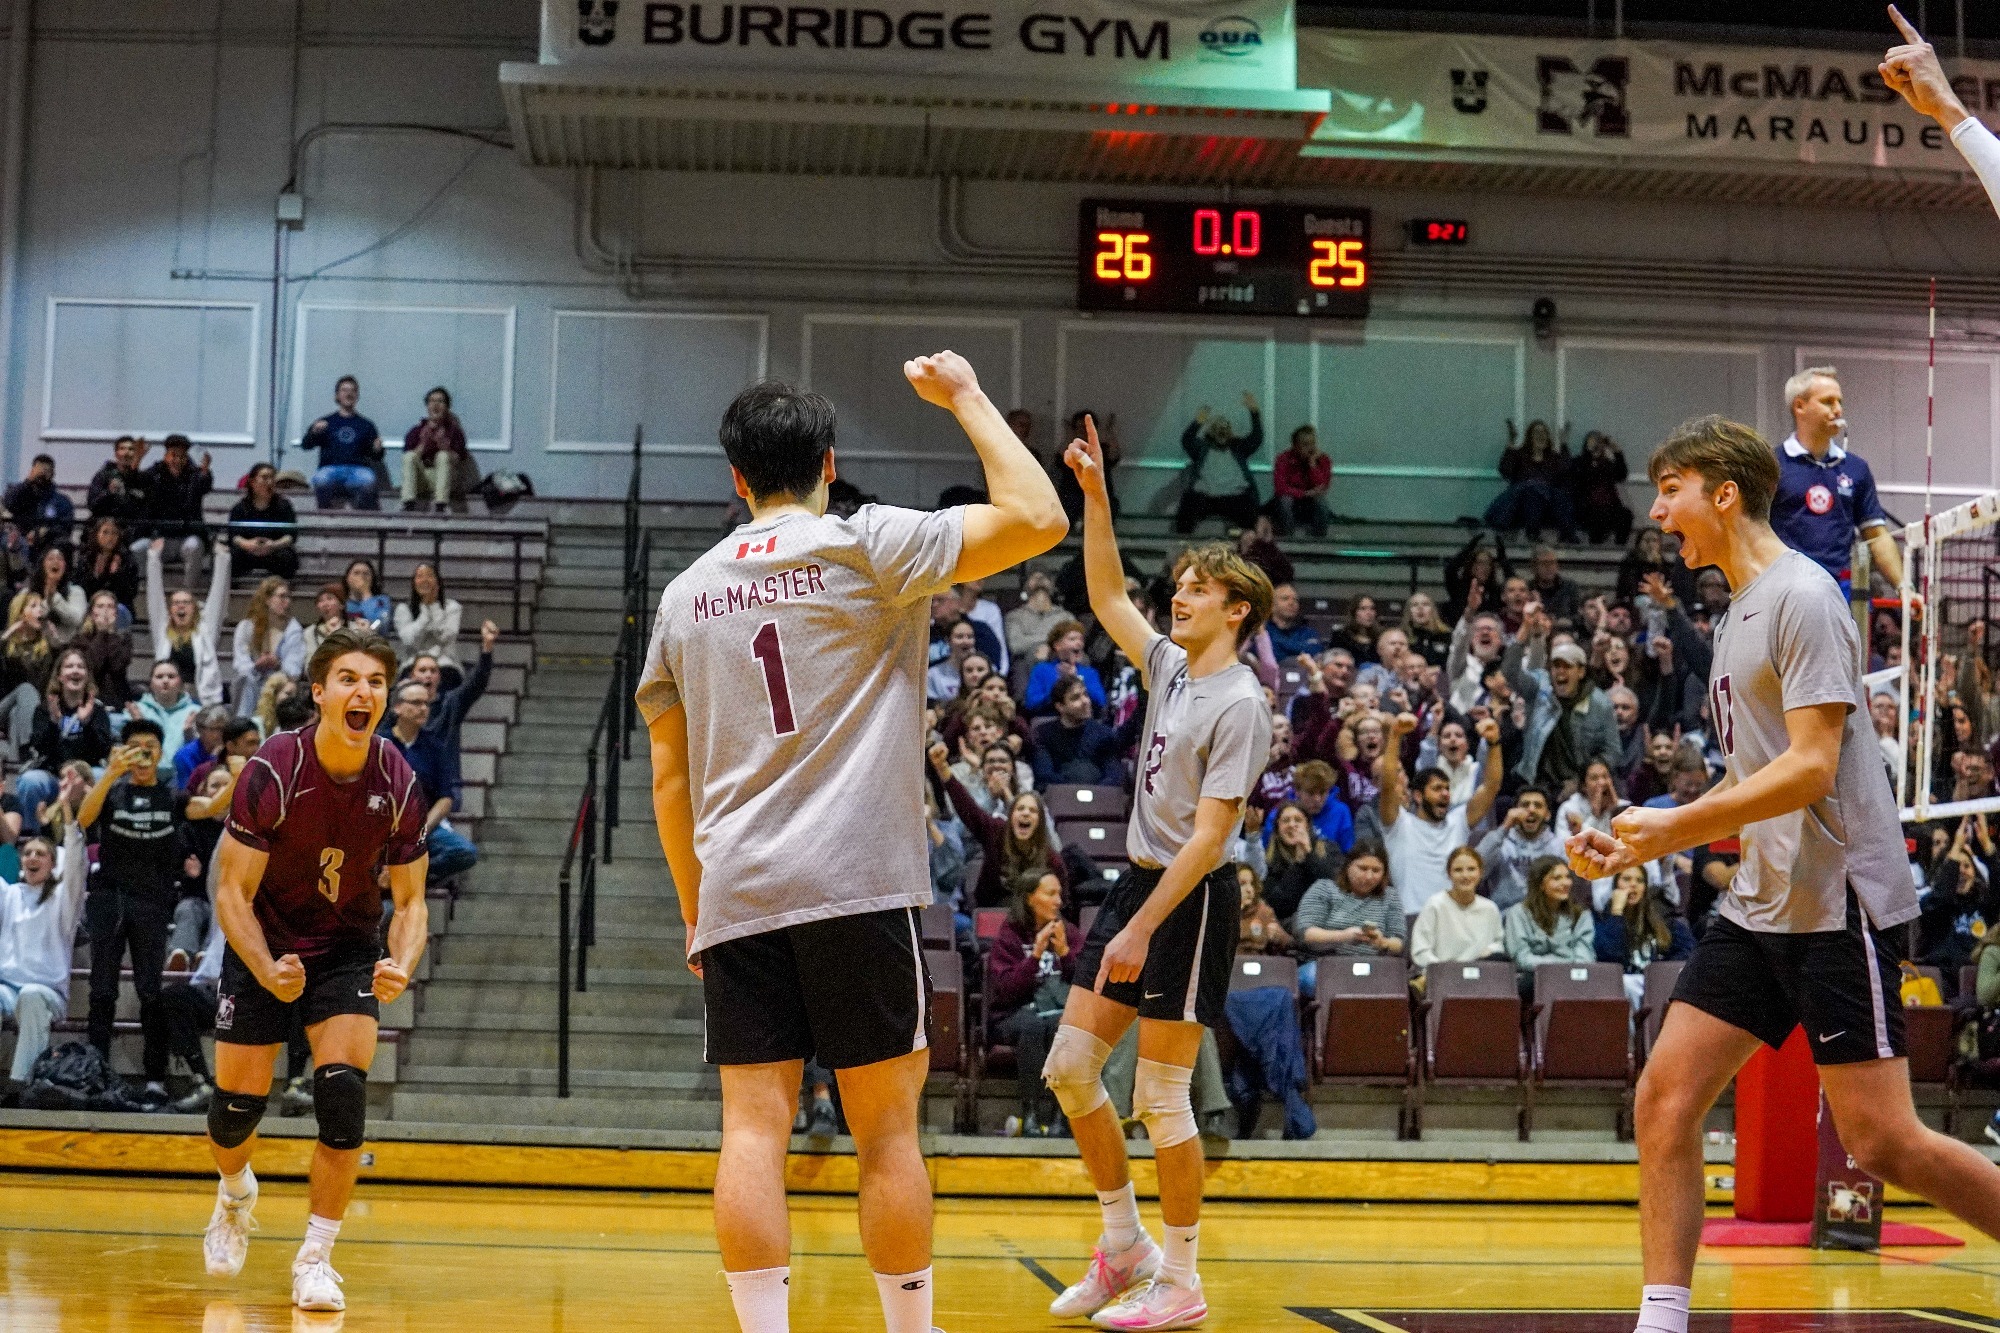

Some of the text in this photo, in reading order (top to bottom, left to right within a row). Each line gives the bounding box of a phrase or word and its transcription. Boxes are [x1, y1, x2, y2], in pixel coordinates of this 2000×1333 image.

[643, 3, 1170, 61] BURRIDGE GYM
[1673, 60, 2000, 111] McMASE
[1685, 113, 1944, 150] MARAUDE
[1096, 233, 1152, 280] 26
[1193, 209, 1261, 256] 0.0
[1309, 240, 1365, 287] 25
[692, 562, 828, 626] McMASTER
[749, 618, 800, 739] 1
[1711, 672, 1735, 759] 17
[317, 846, 345, 904] 3
